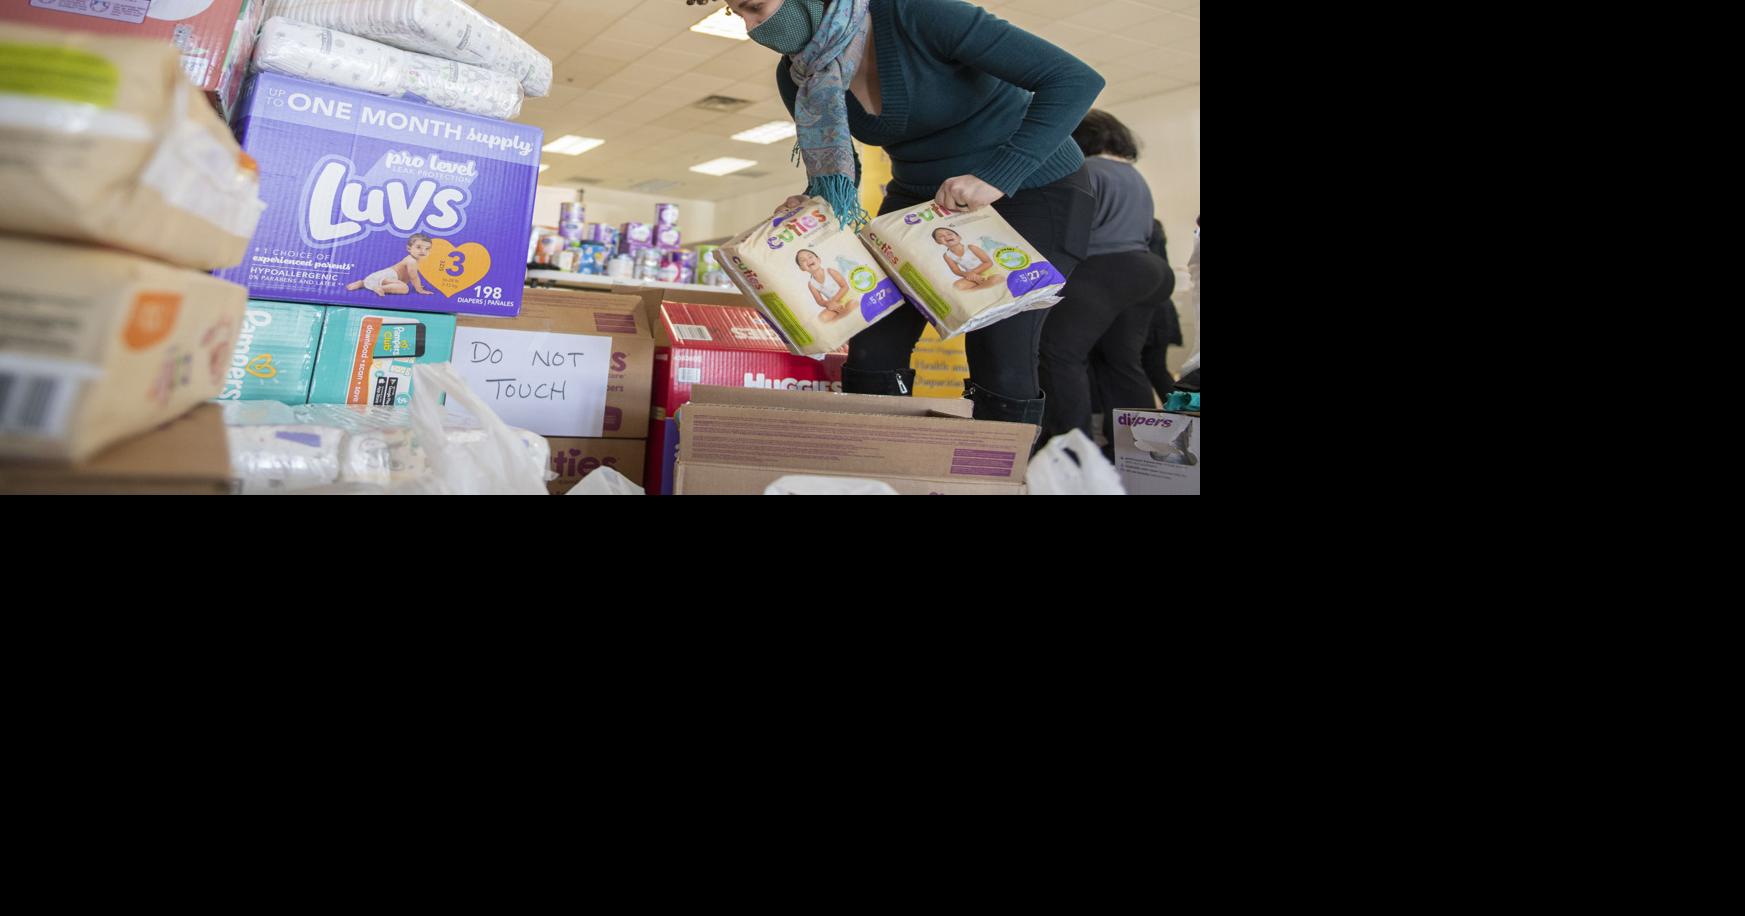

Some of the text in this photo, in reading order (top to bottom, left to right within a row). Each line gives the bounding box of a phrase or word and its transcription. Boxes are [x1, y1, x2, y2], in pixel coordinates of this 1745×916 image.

[269, 88, 286, 97] UP
[287, 93, 353, 121] ONE
[361, 107, 462, 140] MONTH
[385, 149, 479, 177] pro level
[392, 166, 471, 183] LEAK PROTECTION
[308, 161, 464, 241] Luvs
[252, 255, 314, 267] experienced
[272, 248, 313, 259] CHOICE
[316, 253, 331, 261] OF
[445, 250, 466, 277] 3
[250, 266, 339, 281] HYPOALLERGENIC
[260, 275, 297, 284] PARABENS
[474, 285, 502, 299] 198
[876, 288, 886, 301] 27
[457, 297, 484, 305] DIAPERS
[361, 324, 375, 359] download
[471, 341, 503, 365] DO
[531, 350, 584, 368] NOT
[357, 363, 366, 381] scan
[485, 378, 567, 400] TOUCH
